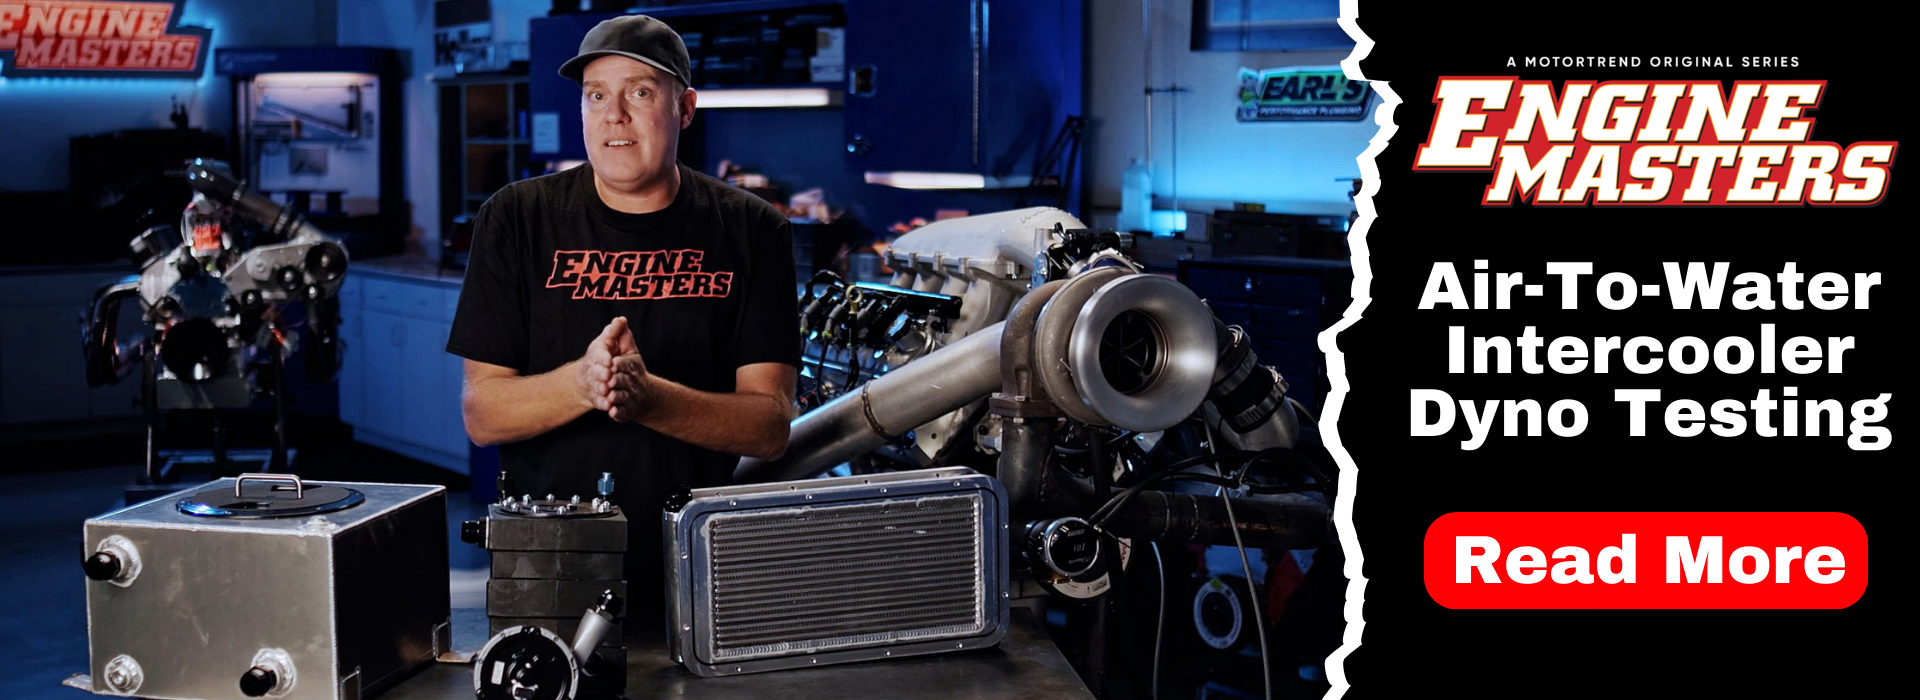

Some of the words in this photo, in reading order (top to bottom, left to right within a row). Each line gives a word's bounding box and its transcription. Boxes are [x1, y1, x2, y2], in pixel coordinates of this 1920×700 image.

[17, 37, 196, 68] MASTERS
[1262, 76, 1365, 100] EARL'S
[1260, 106, 1317, 115] PERFORMANCE
[1320, 106, 1362, 115] PLUMBING
[546, 250, 704, 288] ENGINE
[572, 272, 733, 299] MASTERS
